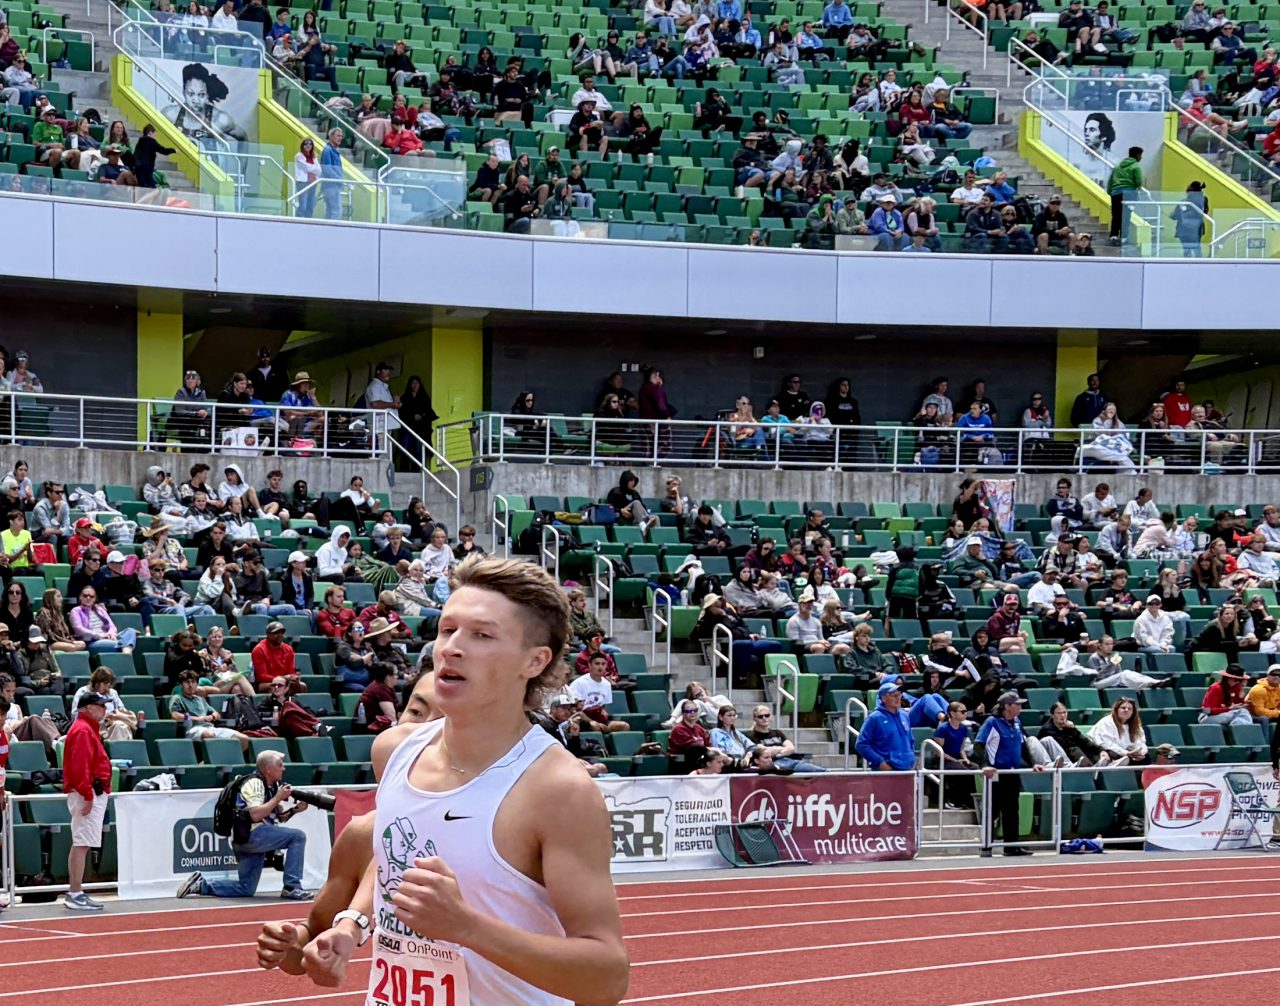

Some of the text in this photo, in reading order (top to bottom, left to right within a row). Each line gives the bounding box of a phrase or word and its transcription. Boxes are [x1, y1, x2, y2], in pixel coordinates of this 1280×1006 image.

[675, 799, 723, 811] SEGURIDAD
[1153, 789, 1221, 821] NSP
[675, 812, 728, 824] TOLERANCIA
[675, 840, 713, 852] RESPETO
[814, 832, 907, 855] multicare
[181, 856, 222, 867] COMMUNITY
[379, 907, 435, 944] SHELD
[378, 934, 453, 960] OSAA OnPoint
